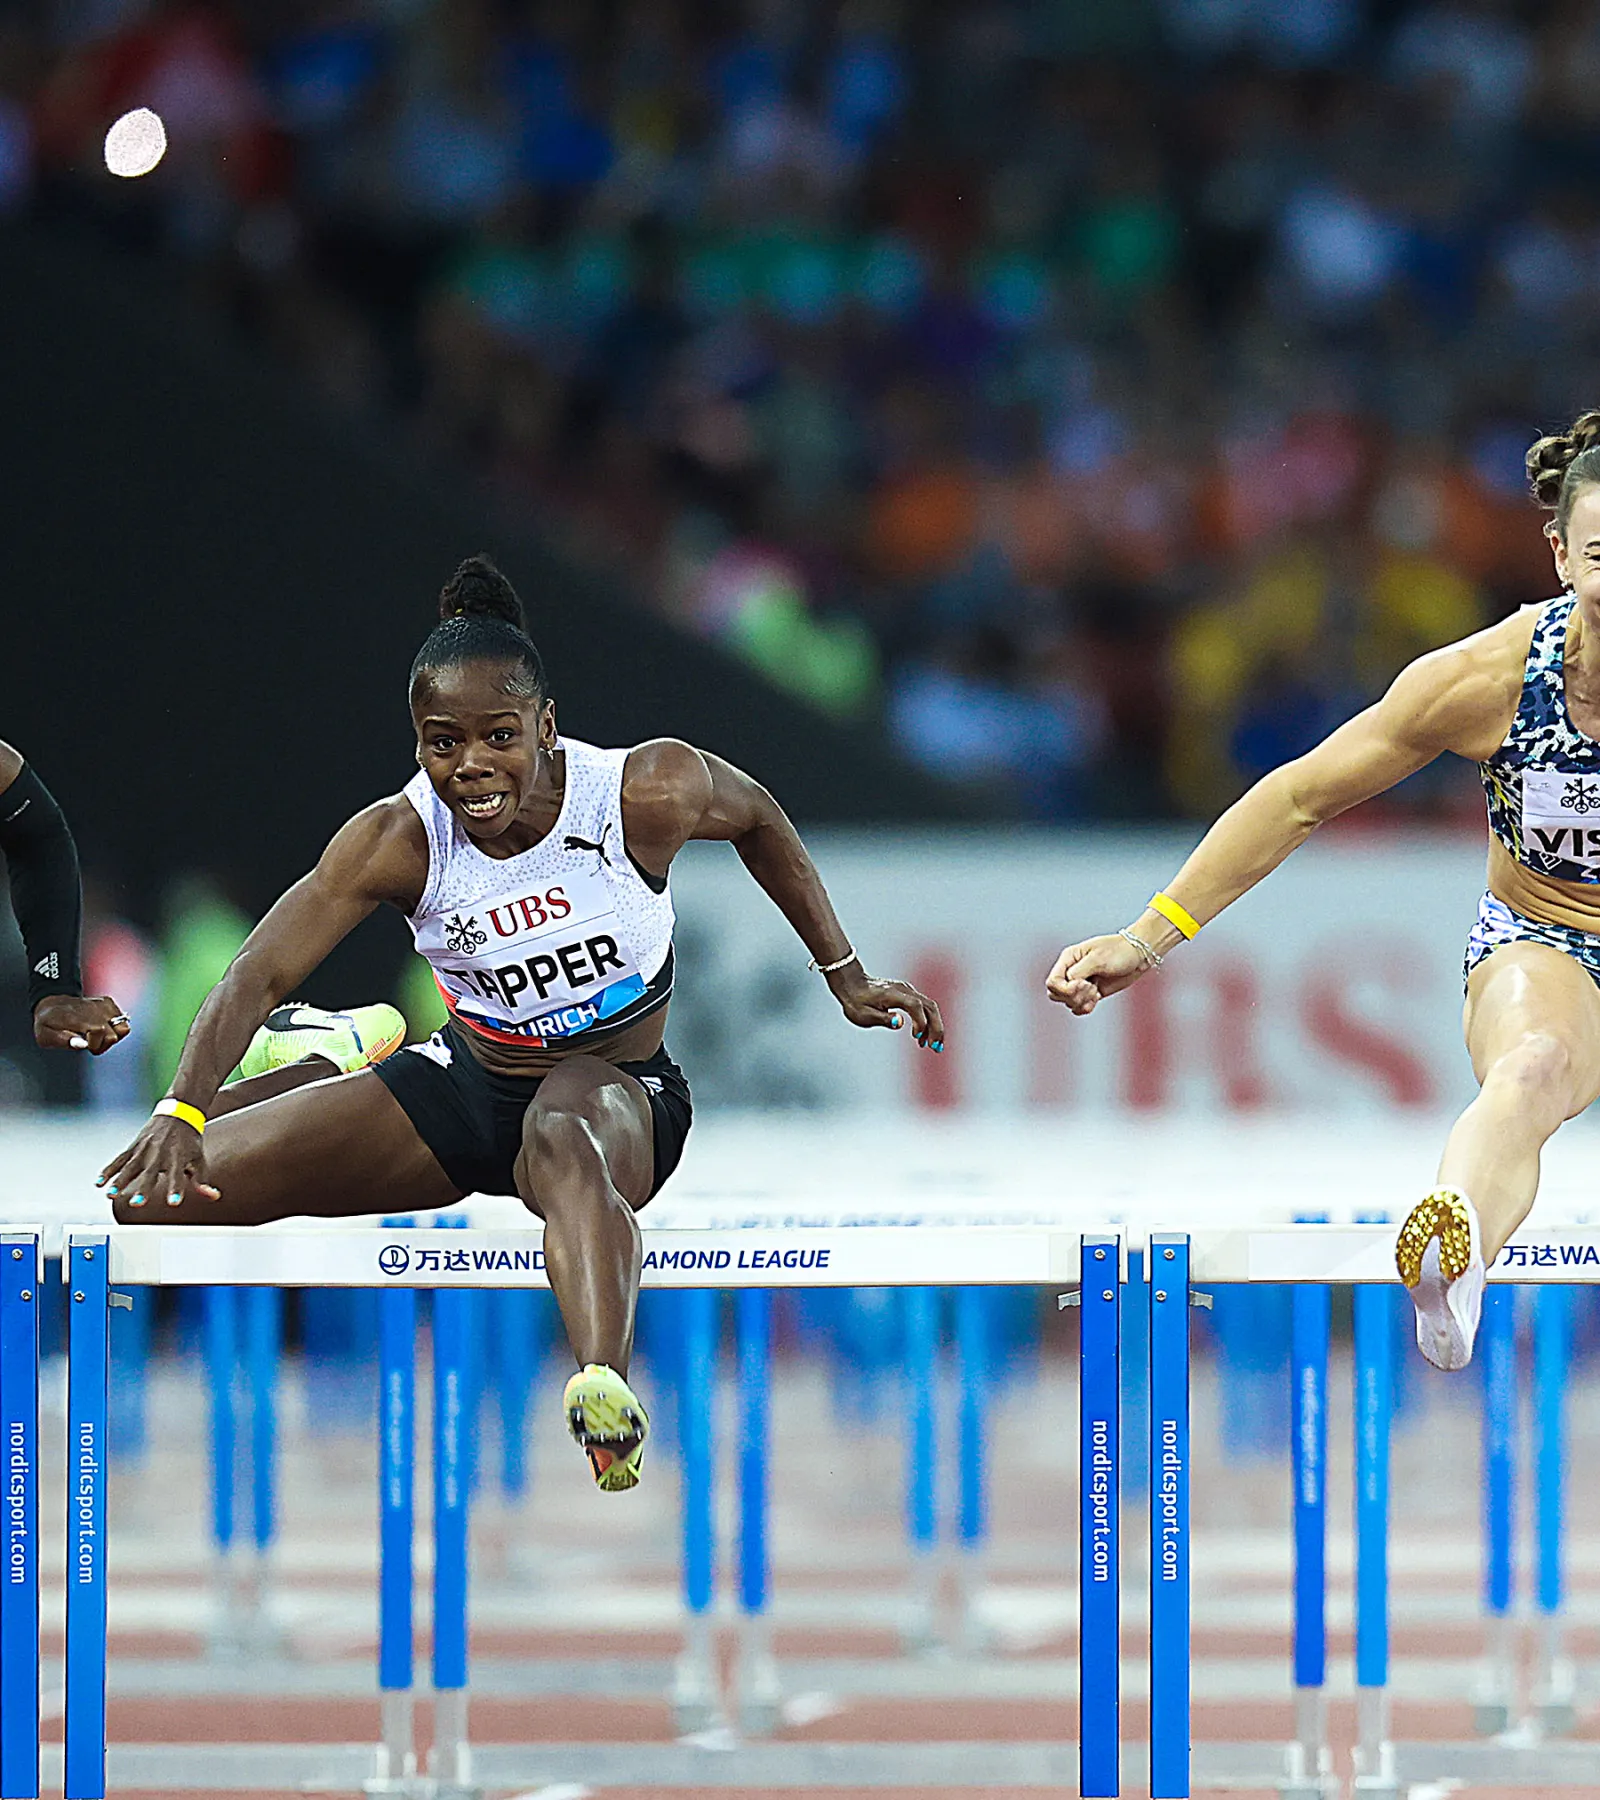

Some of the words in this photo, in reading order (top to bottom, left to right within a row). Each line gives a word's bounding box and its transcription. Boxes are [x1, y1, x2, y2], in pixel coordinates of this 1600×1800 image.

[443, 934, 627, 1009] TAPPER
[485, 886, 572, 938] UBS
[642, 1250, 731, 1269] AMOND
[737, 1250, 831, 1269] LEAGUE
[6, 1422, 30, 1584] nordicsport.com
[75, 1422, 99, 1584] nordicsport.com
[1089, 1420, 1113, 1582] nordicsport.com
[1158, 1419, 1182, 1581] nordicsport.com
